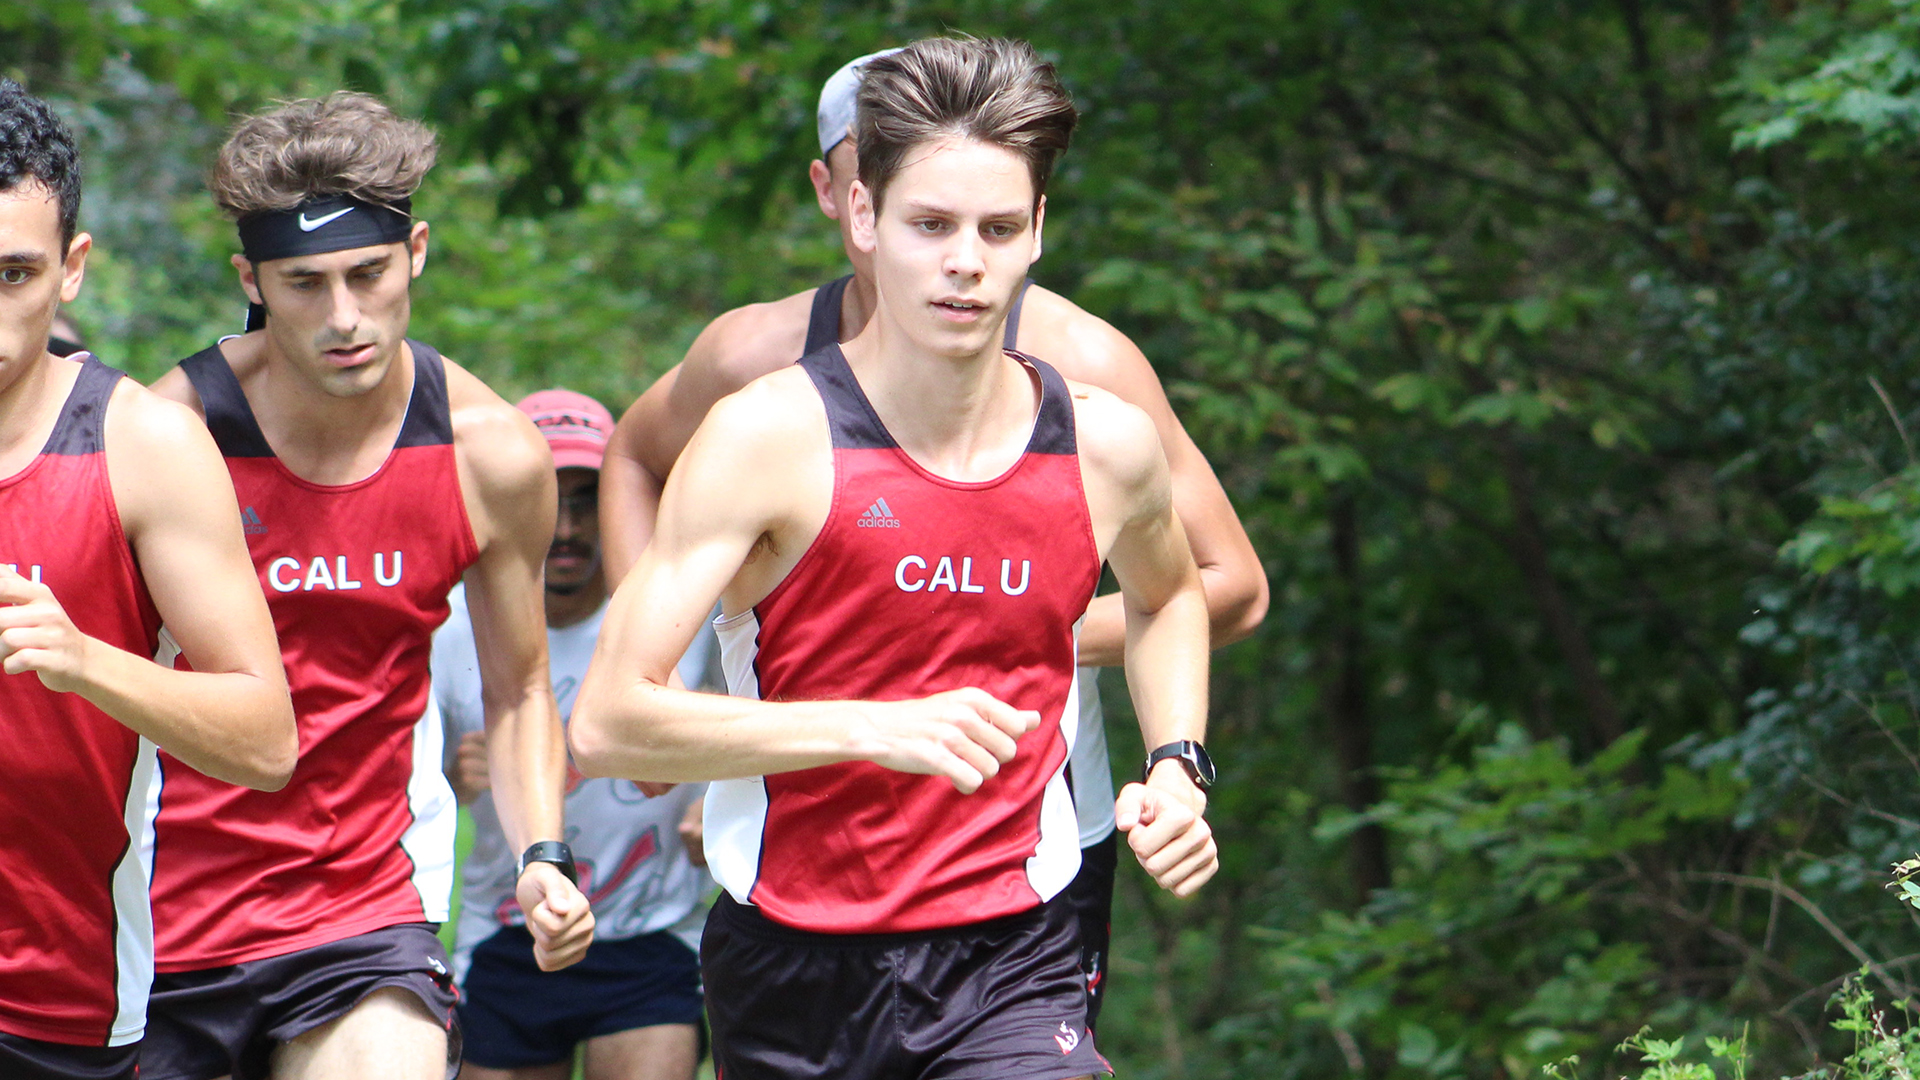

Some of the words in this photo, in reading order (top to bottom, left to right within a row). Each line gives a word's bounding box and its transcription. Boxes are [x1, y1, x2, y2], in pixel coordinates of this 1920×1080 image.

[856, 516, 900, 528] adidas
[268, 556, 362, 593] CAL
[373, 550, 403, 587] U
[894, 554, 985, 594] CAL
[1000, 558, 1031, 596] U
